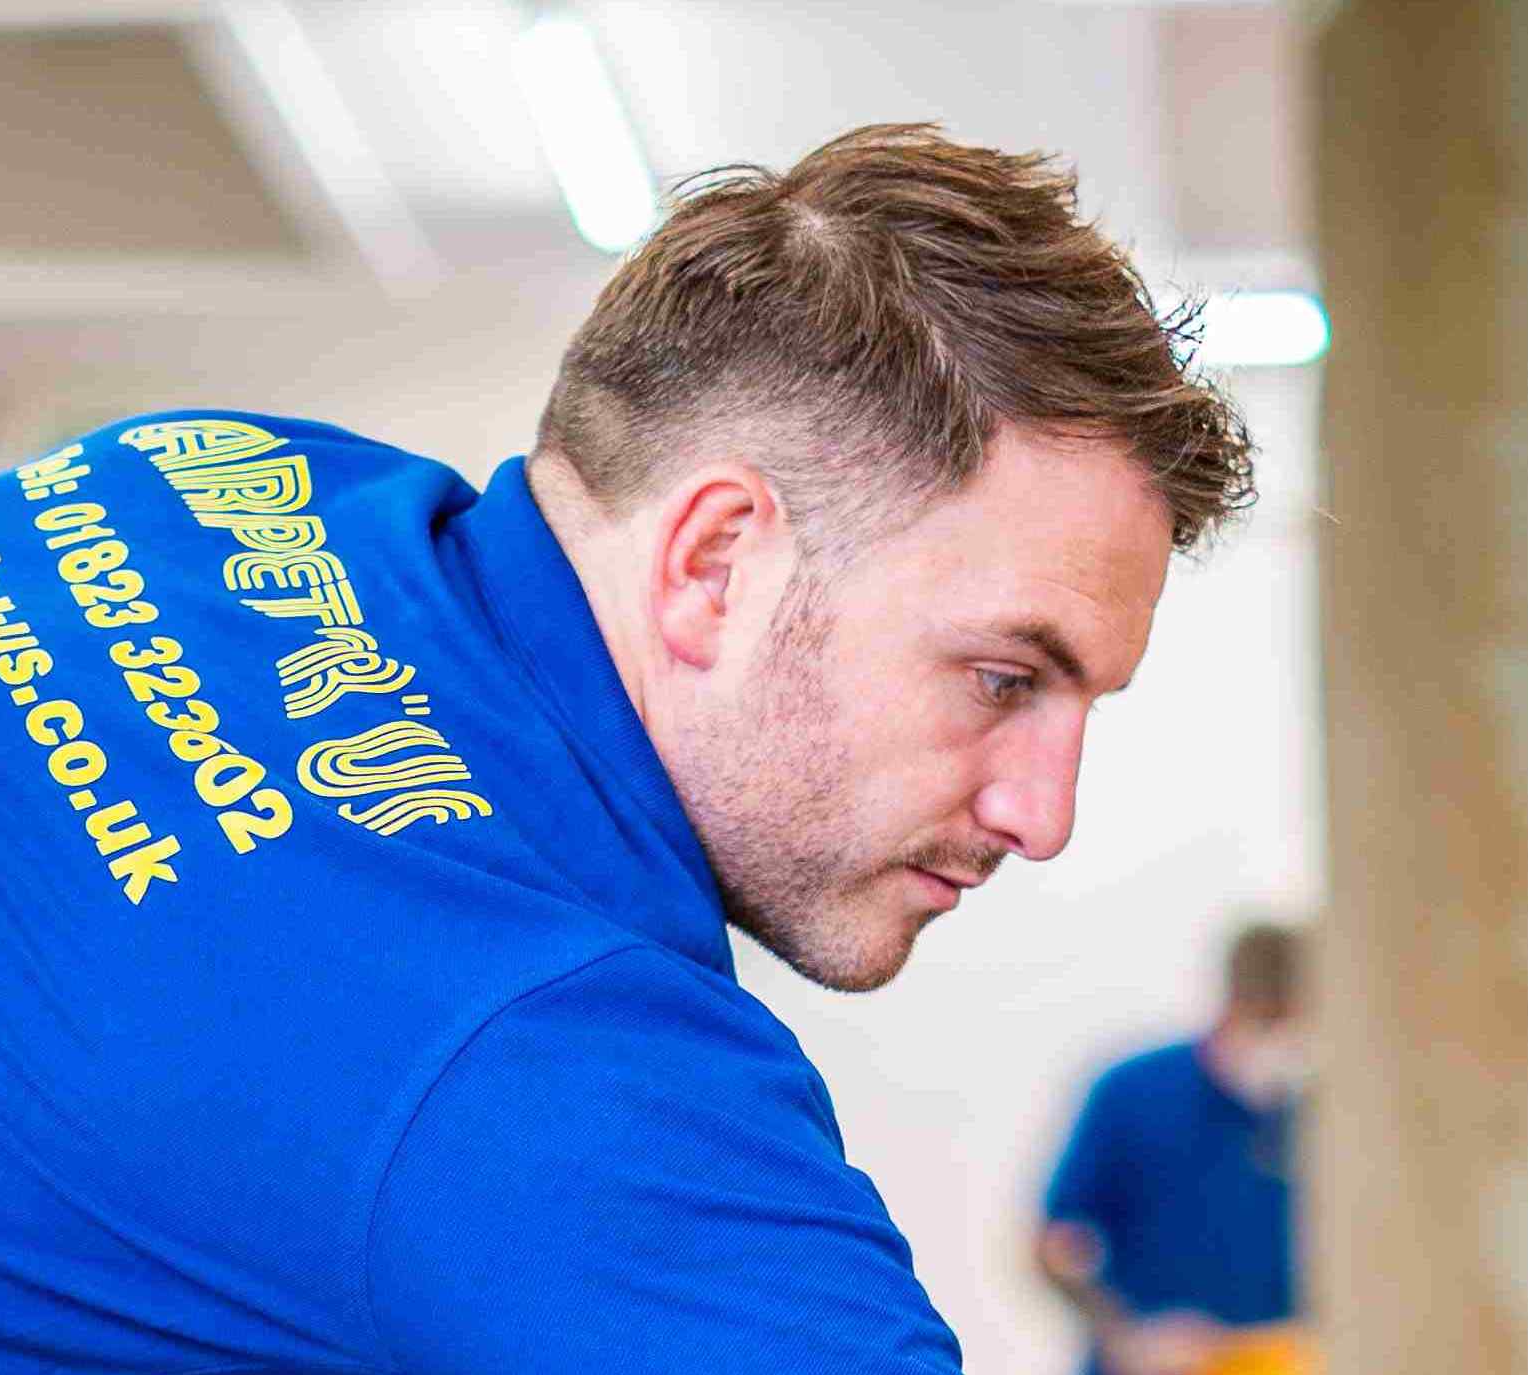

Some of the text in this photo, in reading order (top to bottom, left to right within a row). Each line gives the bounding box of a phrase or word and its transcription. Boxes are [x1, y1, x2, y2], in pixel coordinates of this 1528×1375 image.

[118, 419, 364, 627] ARPET
[33, 503, 159, 628] 01823
[109, 636, 294, 855] 323602
